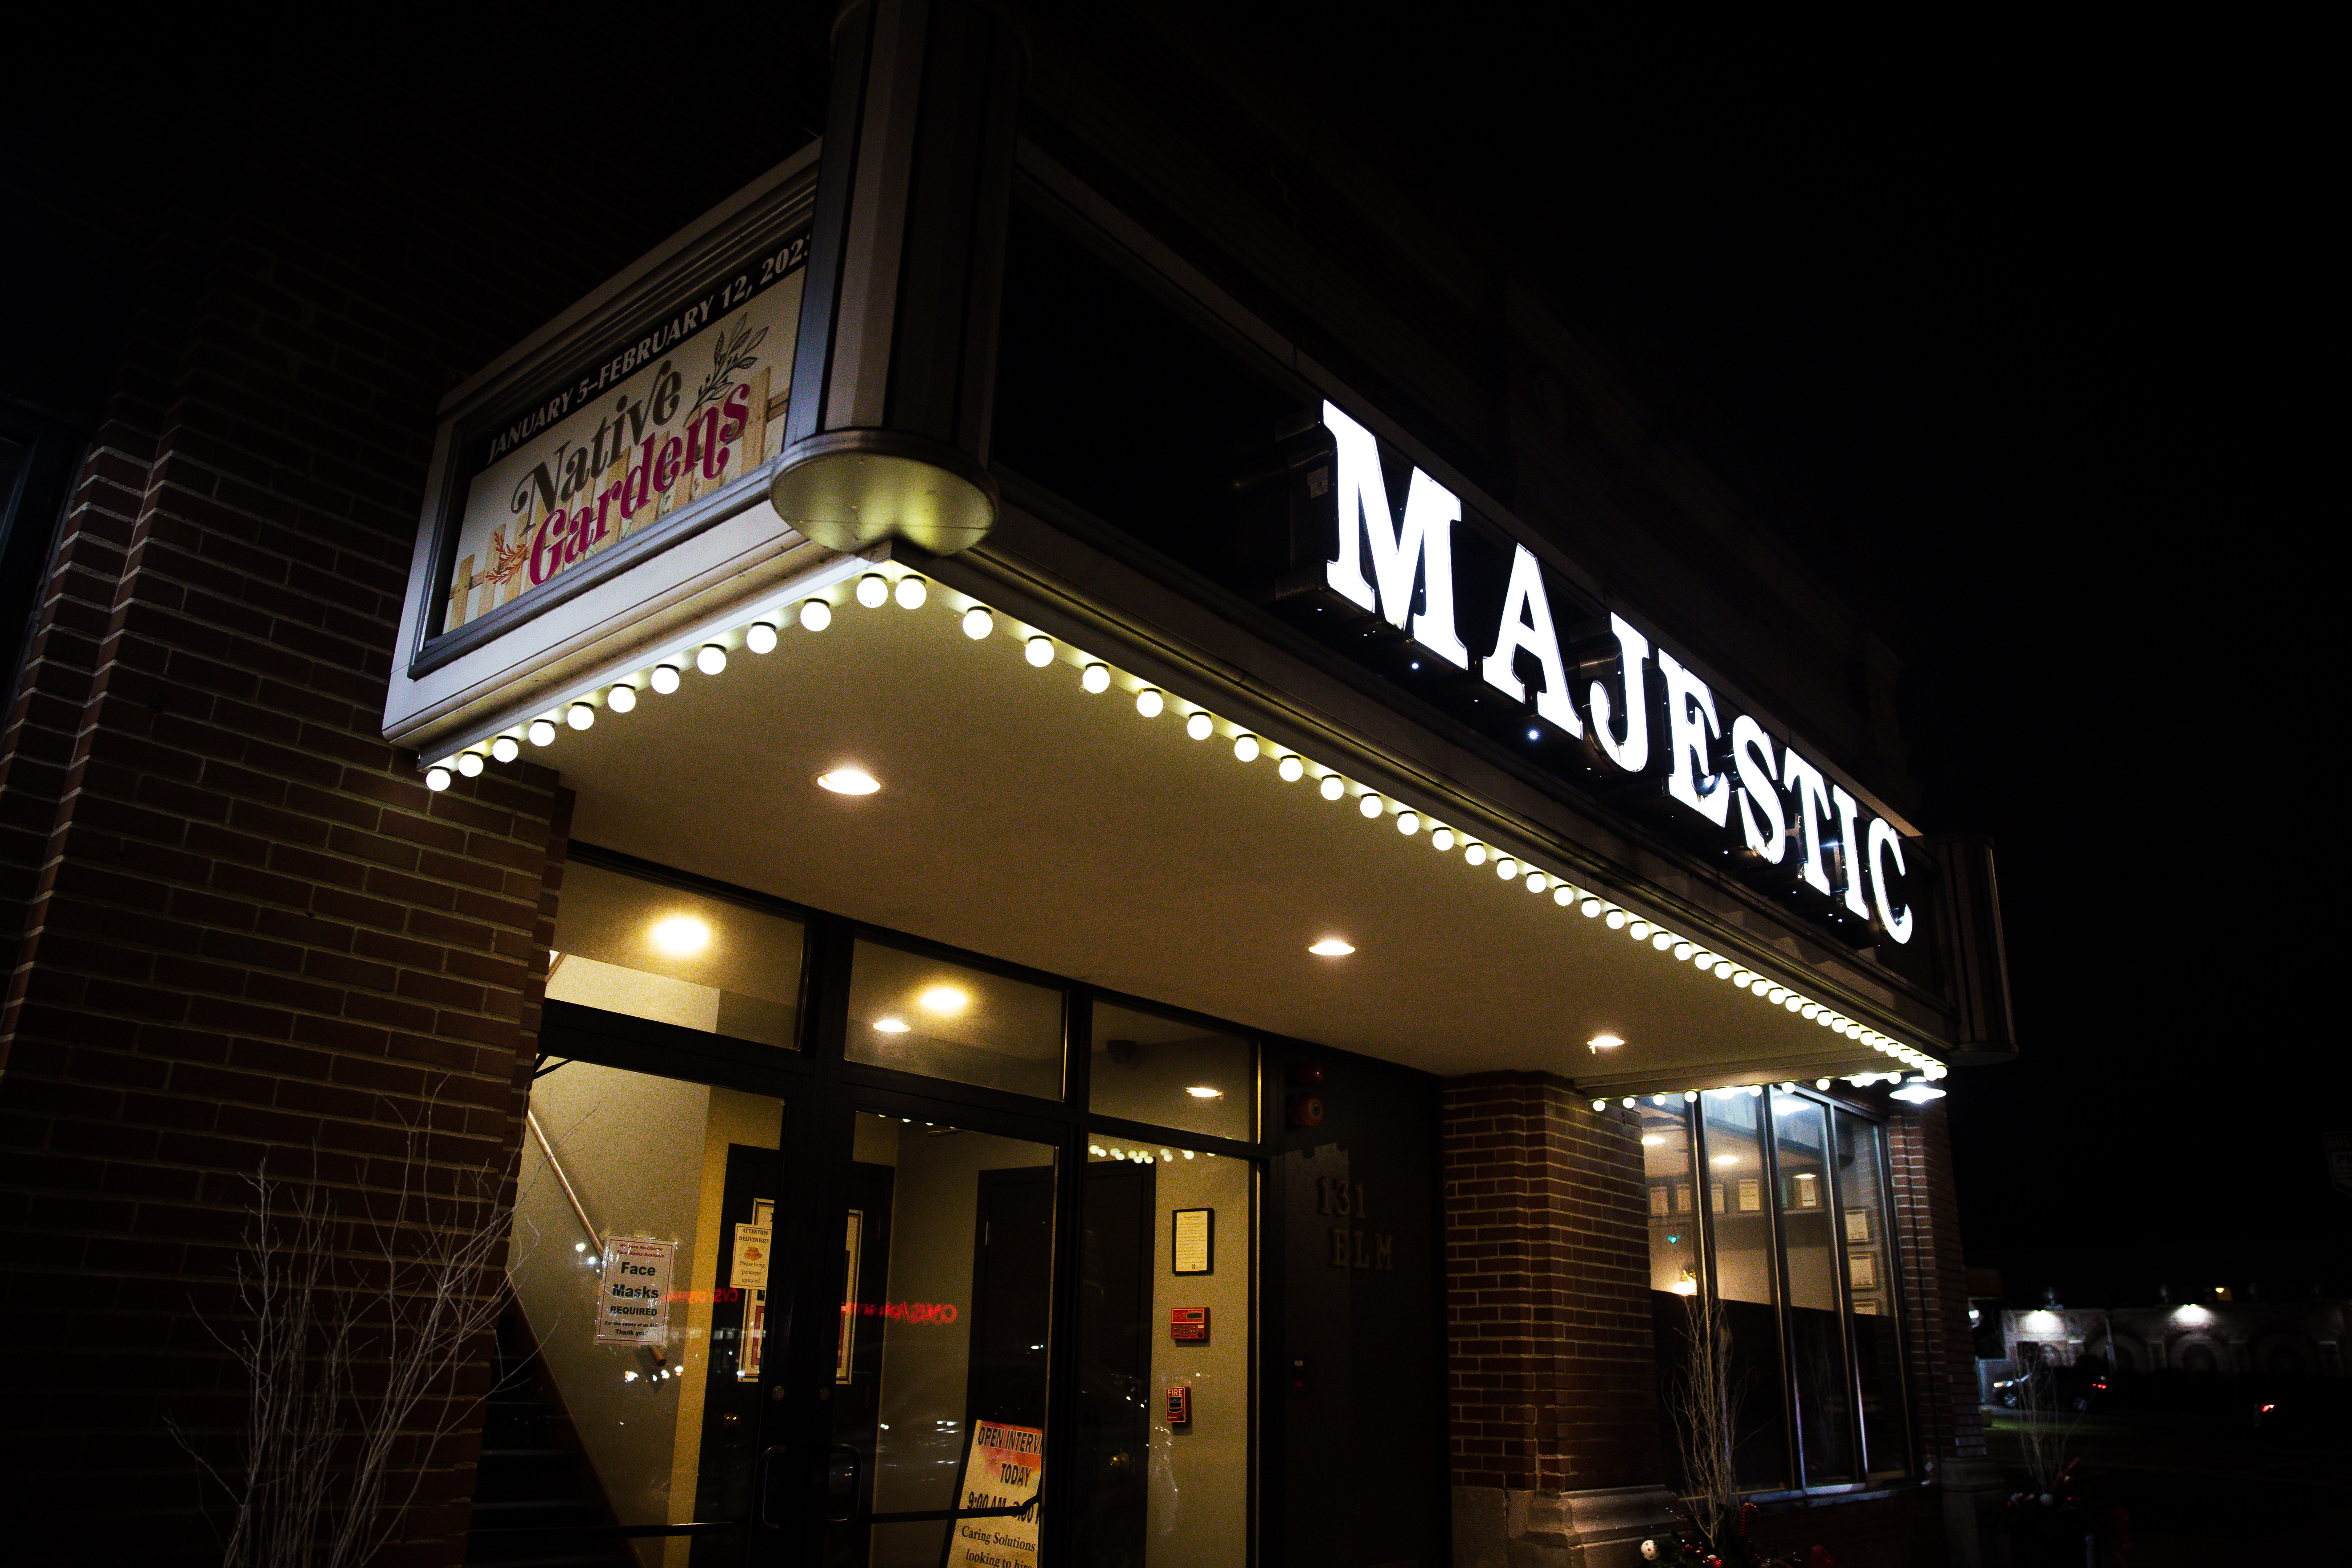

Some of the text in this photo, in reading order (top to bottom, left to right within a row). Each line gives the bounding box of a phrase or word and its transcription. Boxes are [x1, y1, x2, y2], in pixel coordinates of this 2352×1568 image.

[487, 387, 573, 466] JANUARY
[721, 275, 753, 309] 12,
[759, 233, 810, 285] 202
[510, 360, 682, 536] Native
[529, 383, 750, 585] Gardens
[1322, 399, 1913, 945] MAJESTIC
[1317, 1176, 1365, 1220] 131
[1328, 1228, 1393, 1272] ELM
[621, 1261, 656, 1276] Face
[612, 1284, 659, 1298] Masks
[610, 1306, 657, 1316] REQUIRED
[1168, 1388, 1183, 1396] FIRE
[978, 1426, 1005, 1449] OPEN
[1000, 1462, 1032, 1487] TODAY
[961, 1526, 1036, 1552] Caring Solutions
[965, 1548, 1000, 1568] looking
[1002, 1558, 1012, 1568] to
